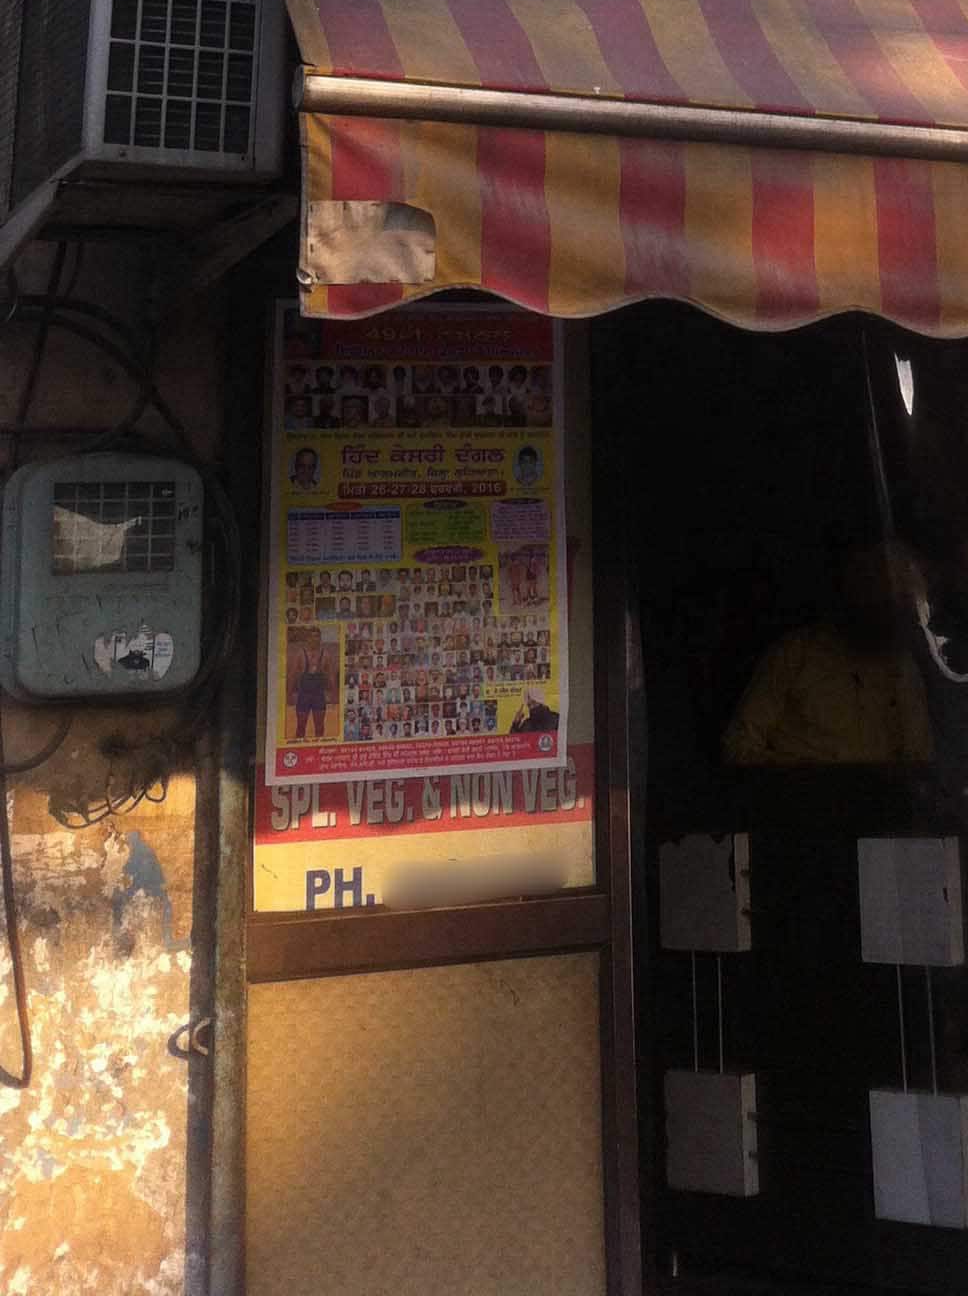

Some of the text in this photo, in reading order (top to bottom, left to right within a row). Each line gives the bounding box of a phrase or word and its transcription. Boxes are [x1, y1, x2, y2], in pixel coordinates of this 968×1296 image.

[270, 758, 587, 832] SPL. VEG. & NON VEG.
[304, 866, 376, 912] PH.
